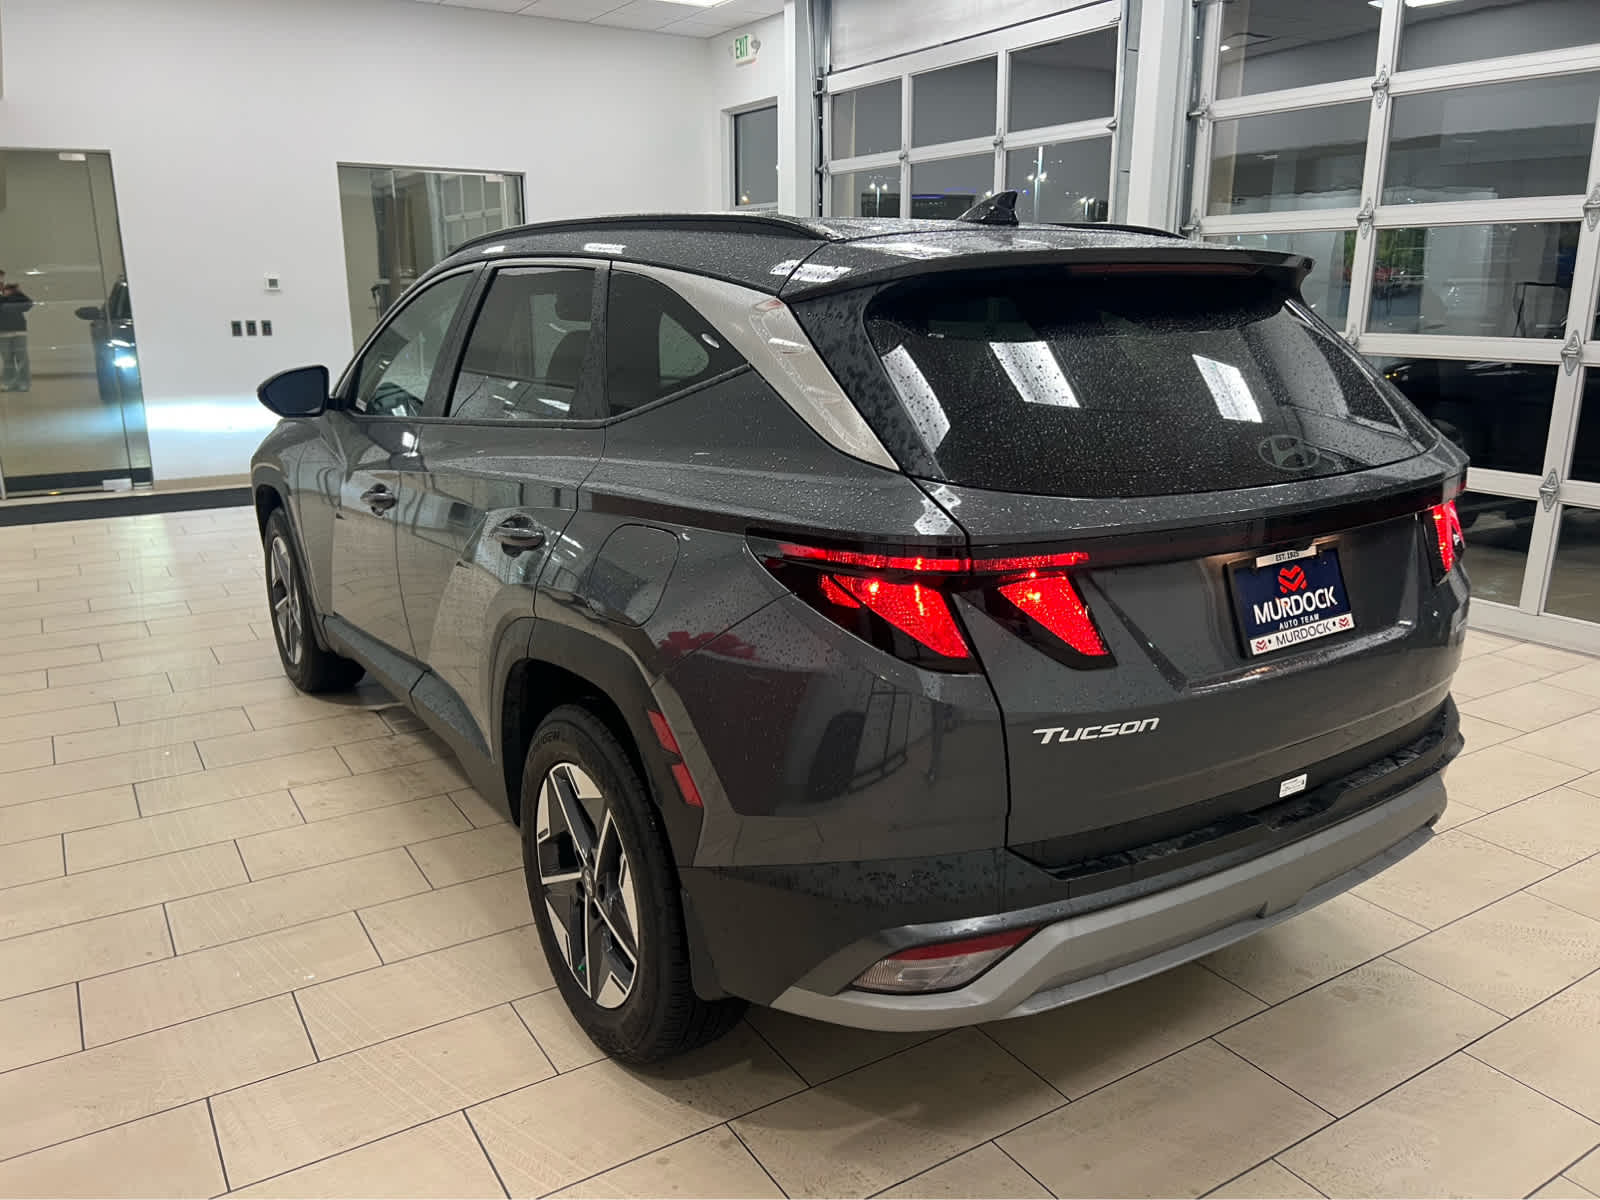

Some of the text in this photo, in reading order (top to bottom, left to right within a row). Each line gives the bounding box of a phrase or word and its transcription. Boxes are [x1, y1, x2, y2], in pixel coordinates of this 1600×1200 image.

[735, 35, 750, 60] EXIT
[1253, 585, 1338, 625] MURDOCK
[1275, 621, 1332, 646] MURDOCK
[1279, 613, 1320, 631] AUTO TEAM
